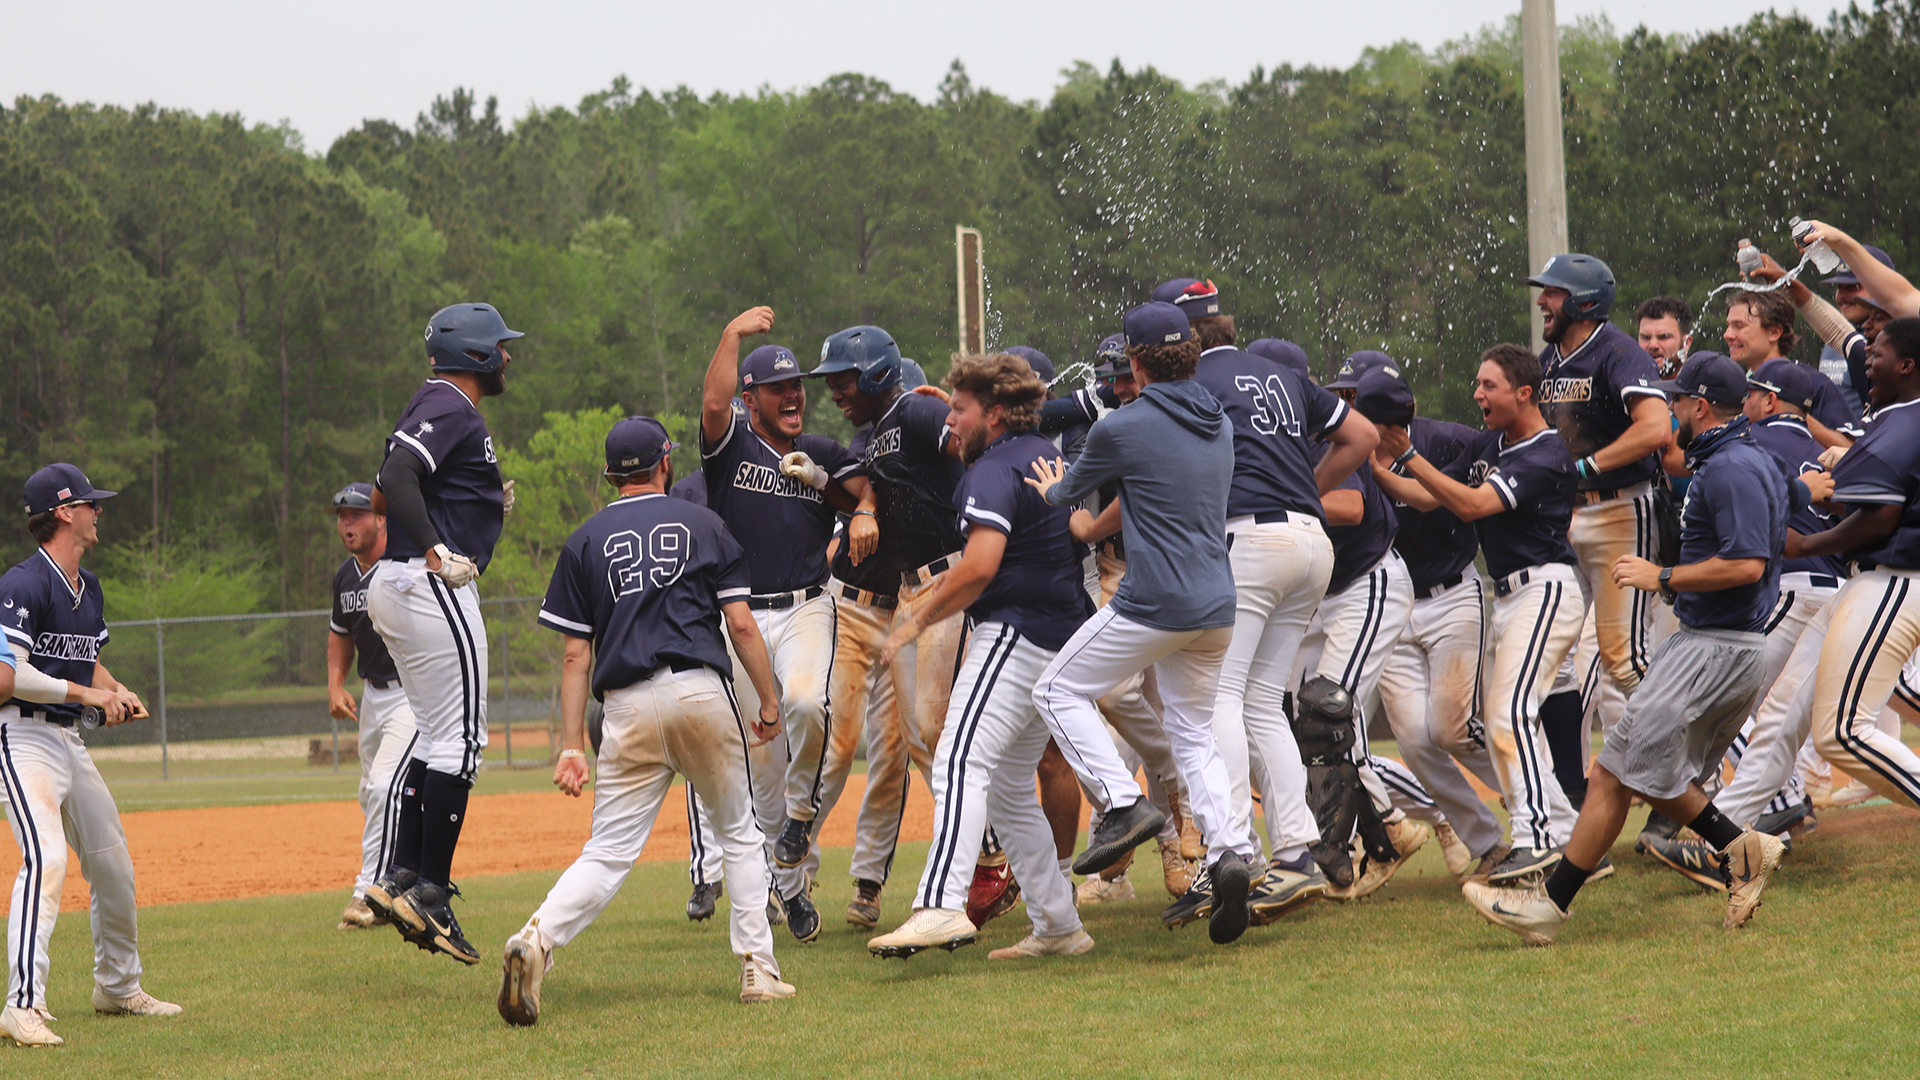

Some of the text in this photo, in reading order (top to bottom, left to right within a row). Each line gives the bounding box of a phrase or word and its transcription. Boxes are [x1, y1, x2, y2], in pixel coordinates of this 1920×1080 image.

[1235, 374, 1300, 437] 31
[1552, 377, 1593, 403] SHARKS
[733, 461, 776, 493] SAND
[603, 523, 690, 603] 29
[32, 632, 73, 660] SAND
